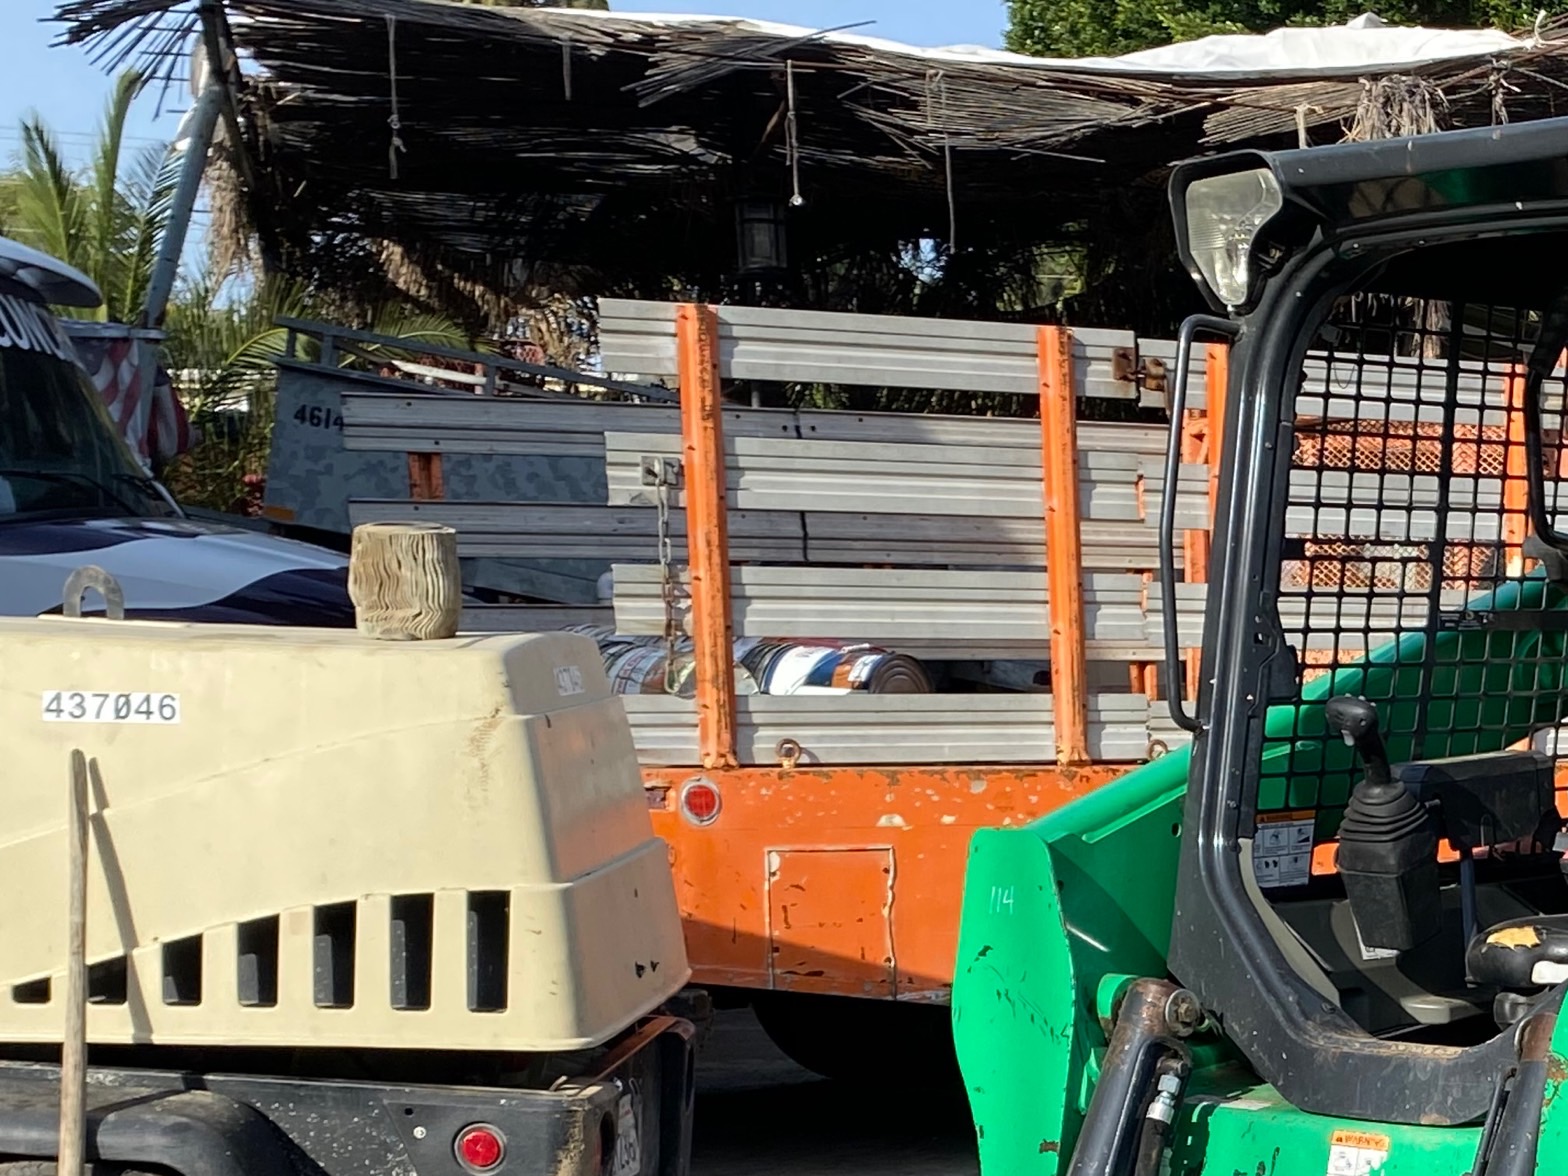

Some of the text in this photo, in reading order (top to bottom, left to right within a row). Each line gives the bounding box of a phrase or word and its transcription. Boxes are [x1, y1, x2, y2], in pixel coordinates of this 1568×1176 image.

[293, 404, 344, 431] 4614
[44, 692, 176, 720] 437046
[989, 885, 1014, 915] 114
